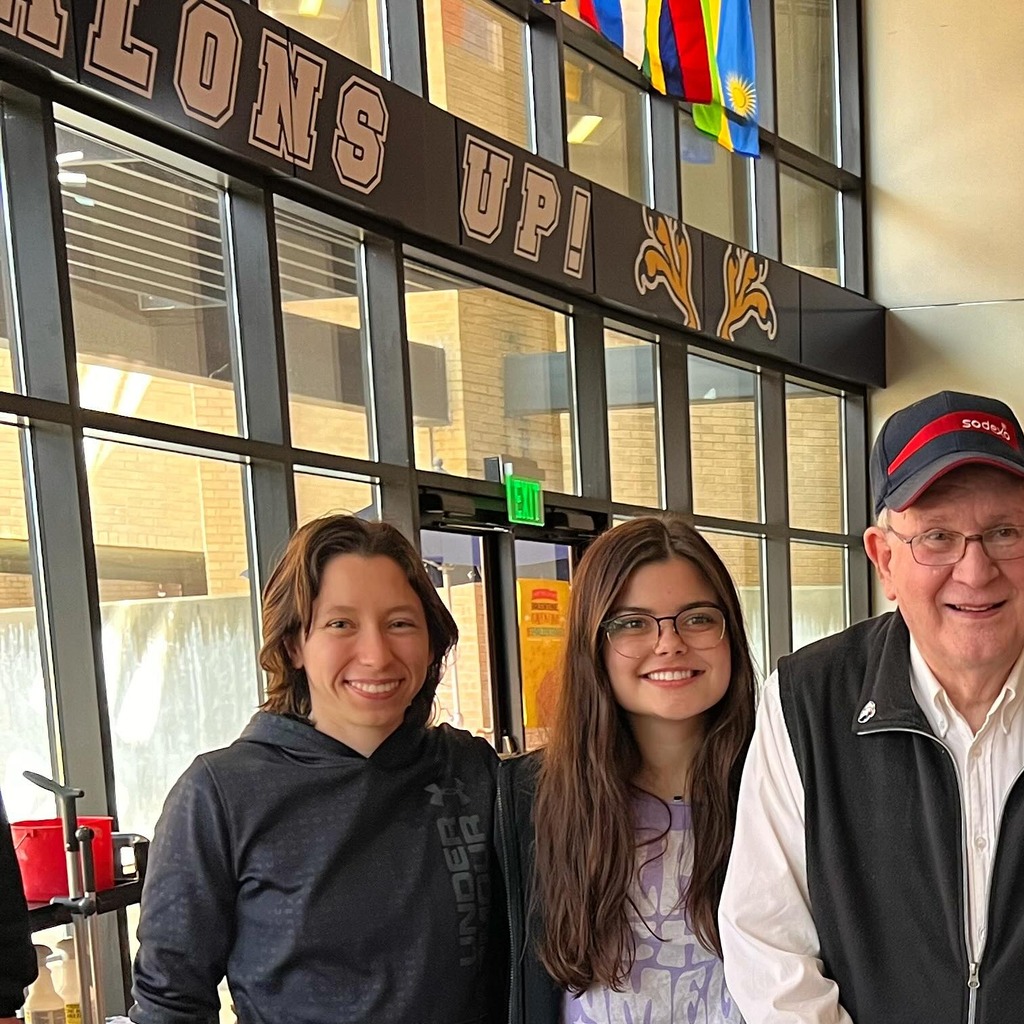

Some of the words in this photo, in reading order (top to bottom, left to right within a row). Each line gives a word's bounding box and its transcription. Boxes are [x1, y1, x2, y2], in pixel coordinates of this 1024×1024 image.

[460, 134, 591, 279] UP!
[962, 418, 1011, 441] sodexo
[515, 478, 540, 522] EXIT
[436, 817, 477, 967] UNDER
